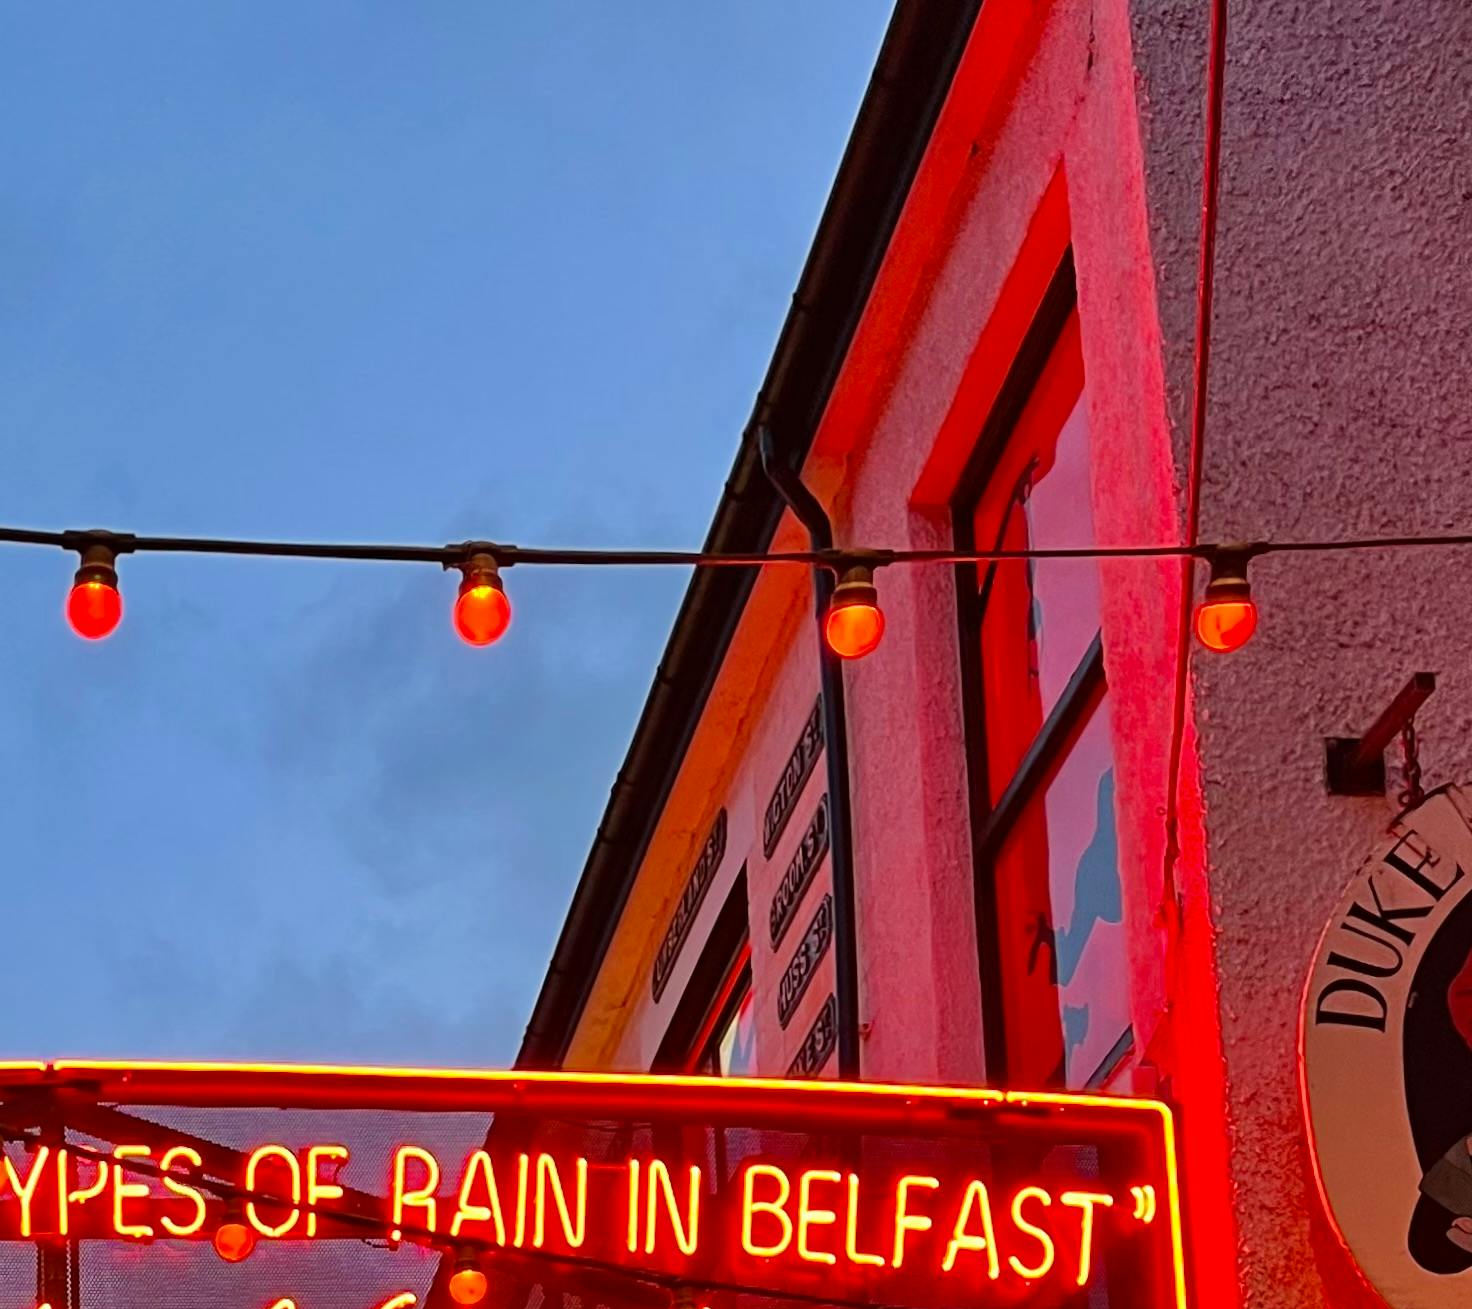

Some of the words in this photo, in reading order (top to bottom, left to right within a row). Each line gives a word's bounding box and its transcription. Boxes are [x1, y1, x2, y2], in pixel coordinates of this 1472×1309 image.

[1316, 828, 1465, 1033] DUKE
[245, 1145, 349, 1238] OF
[390, 1146, 588, 1248] RAIN
[628, 1156, 701, 1256] IN
